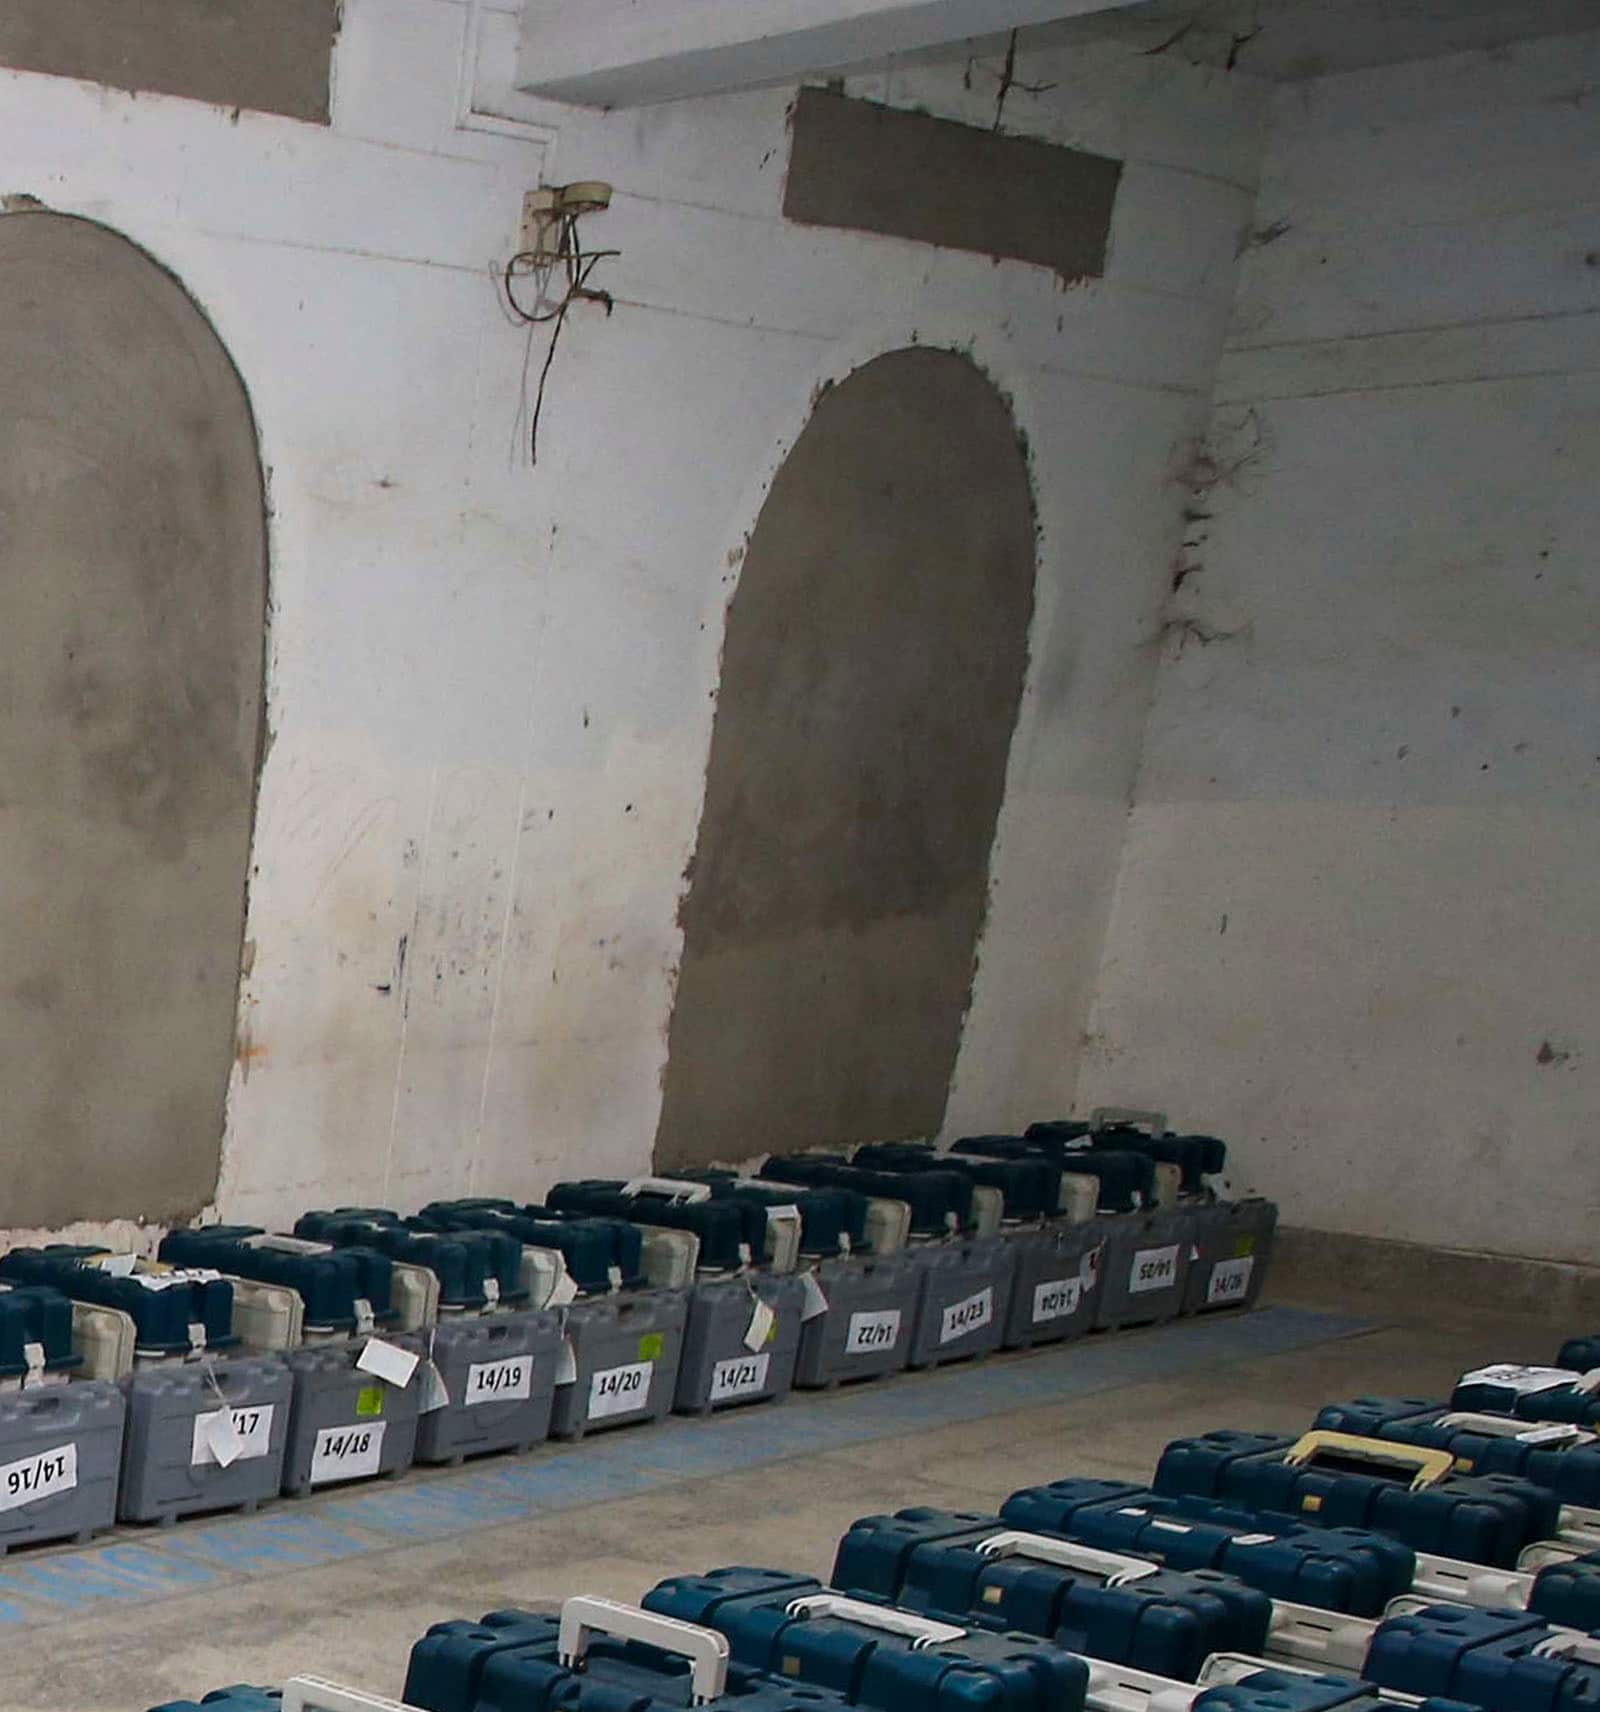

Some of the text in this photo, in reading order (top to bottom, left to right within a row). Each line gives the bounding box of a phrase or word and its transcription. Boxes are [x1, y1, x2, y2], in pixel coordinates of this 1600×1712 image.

[856, 1324, 894, 1347] 14/22
[475, 1365, 522, 1393] 14/19
[598, 1370, 642, 1397] 14/20
[718, 1365, 758, 1389] 14/21
[322, 1432, 371, 1461] 14/18
[6, 1454, 66, 1496] 14/16
